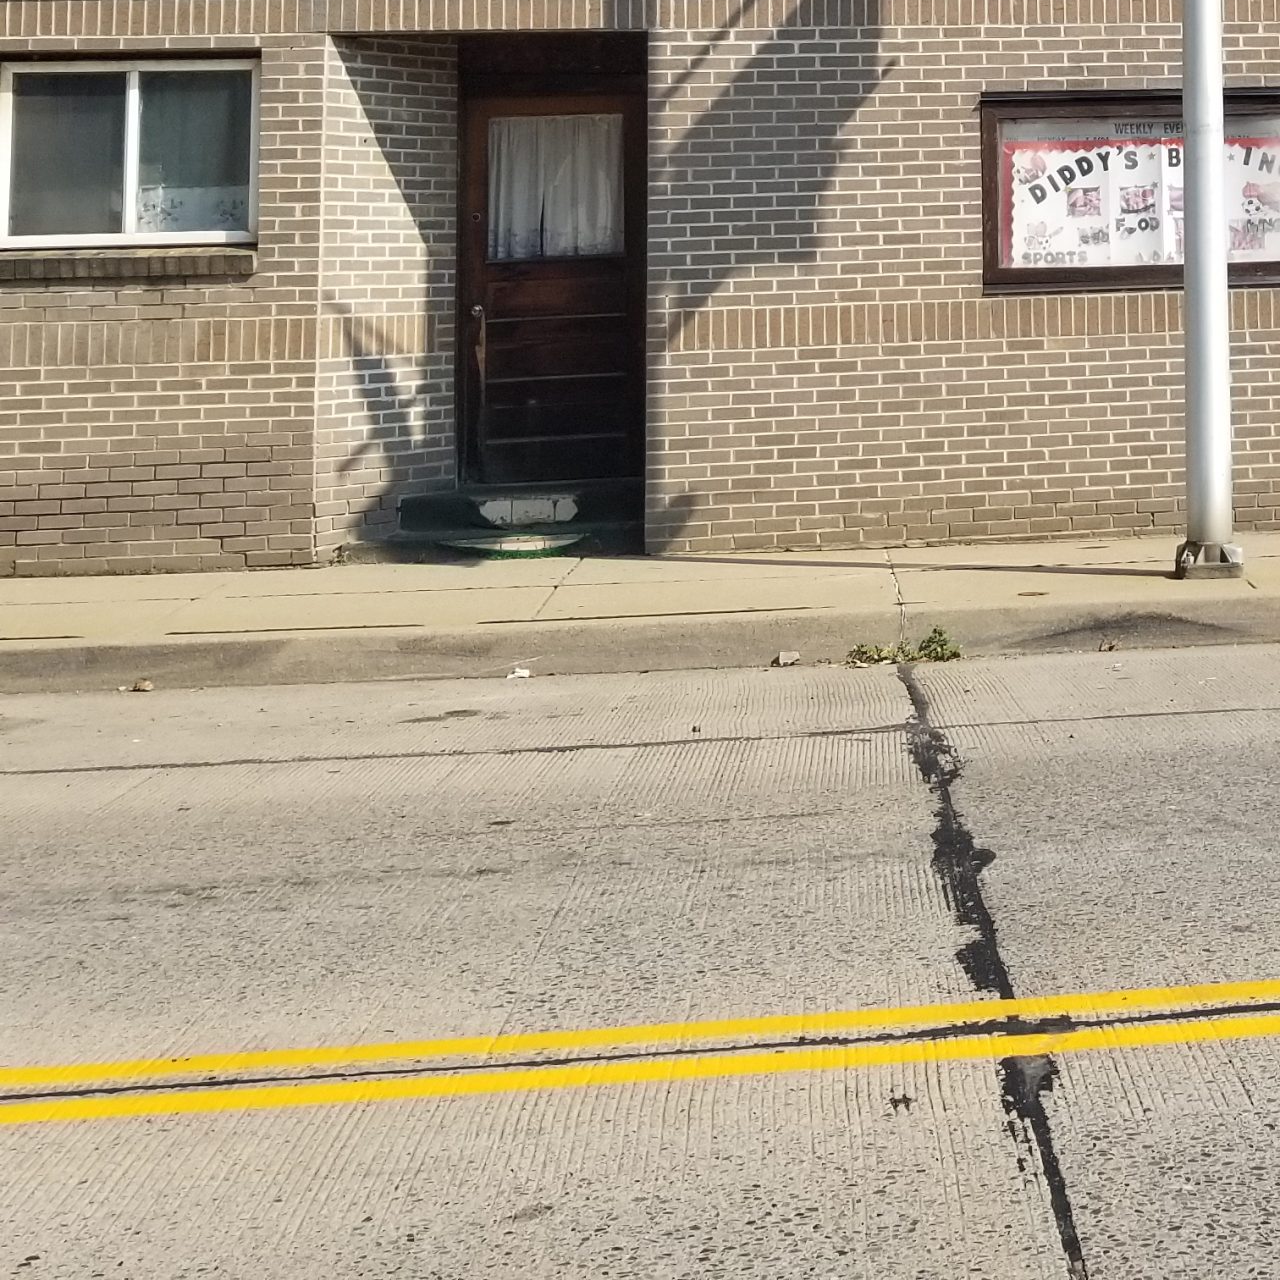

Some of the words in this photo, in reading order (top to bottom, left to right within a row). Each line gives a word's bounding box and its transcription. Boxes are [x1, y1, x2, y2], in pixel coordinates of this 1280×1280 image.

[1114, 122, 1154, 135] WEEKLY
[1163, 121, 1183, 134] EVE
[1028, 145, 1139, 205] DIDDY'S
[1021, 250, 1088, 265] SPORTS
